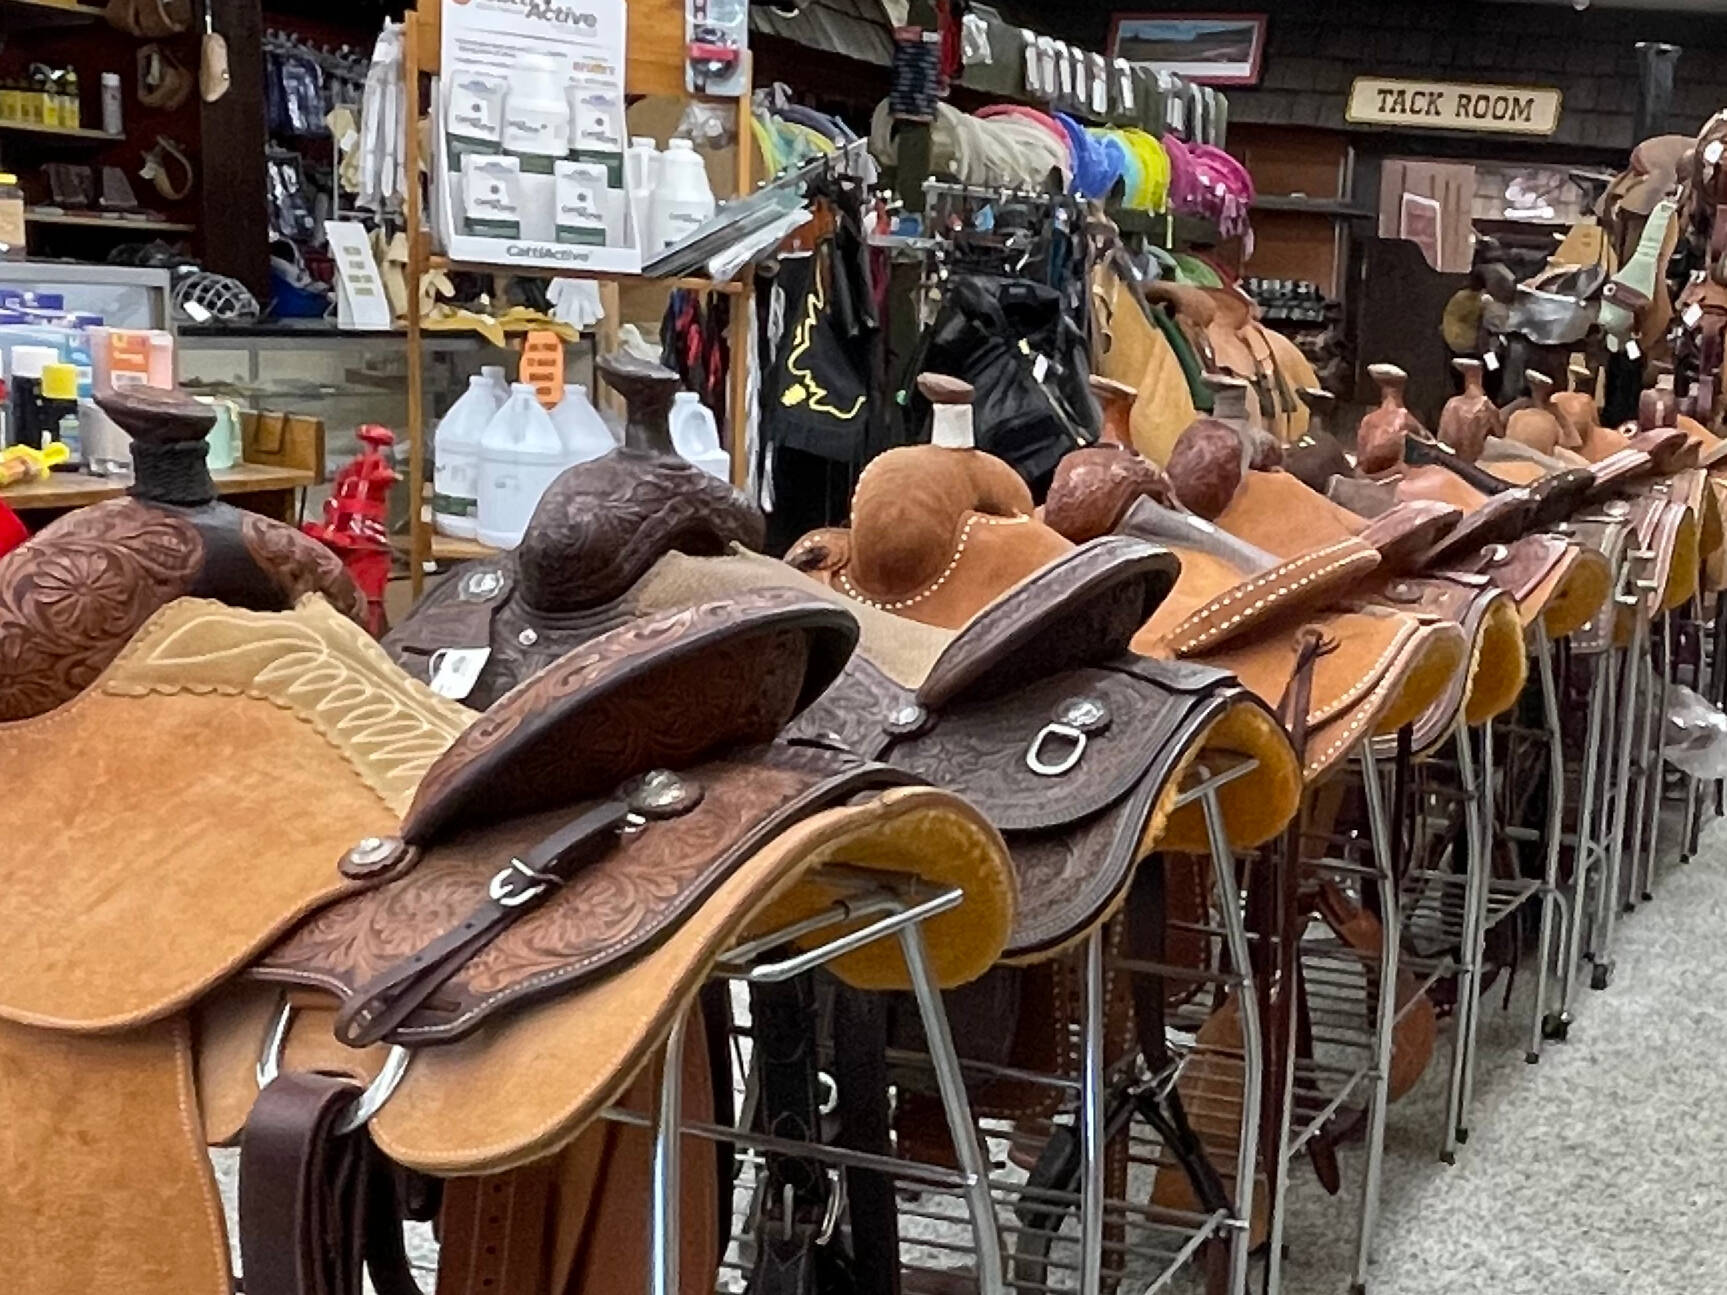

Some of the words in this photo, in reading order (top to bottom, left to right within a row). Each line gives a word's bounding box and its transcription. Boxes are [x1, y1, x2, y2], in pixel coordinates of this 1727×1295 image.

[525, 3, 597, 28] Active
[1377, 88, 1444, 116] TACK
[1455, 93, 1535, 122] ROOM
